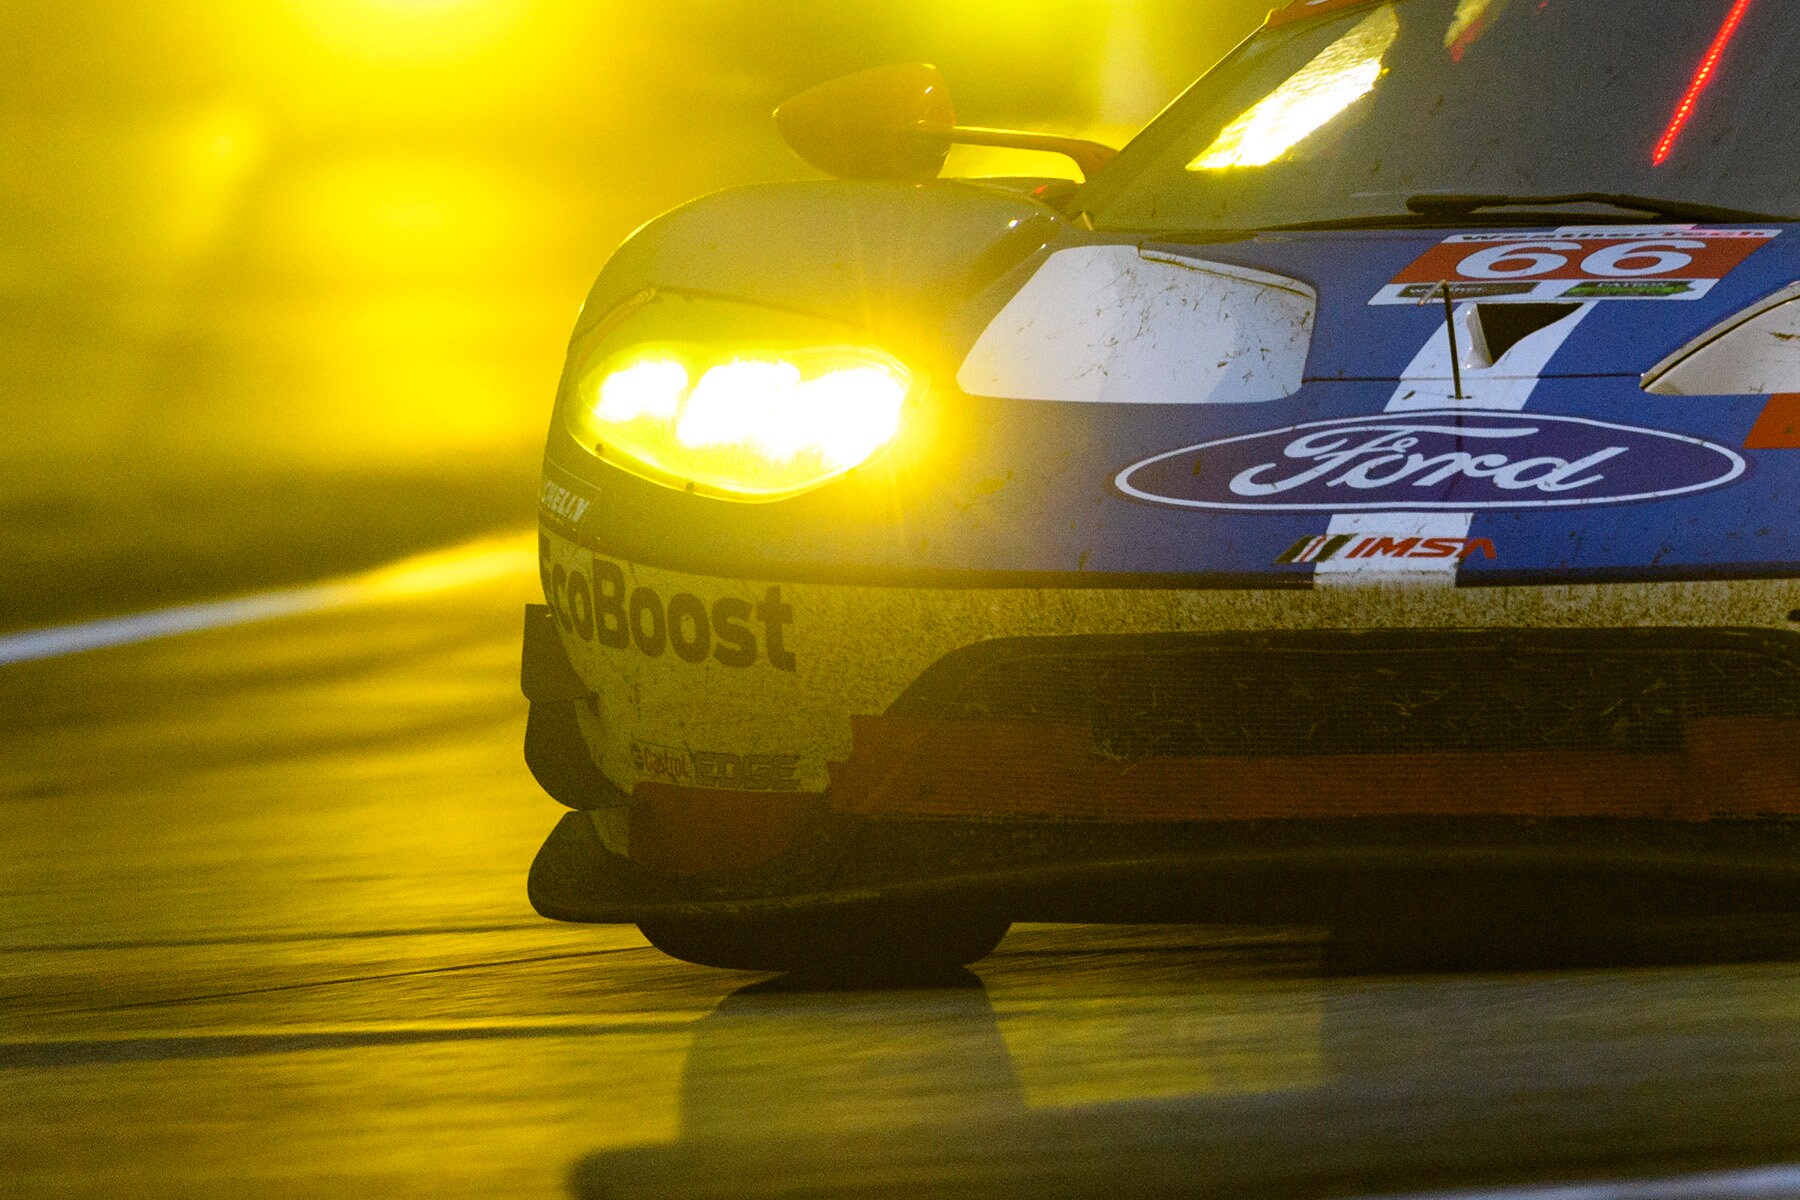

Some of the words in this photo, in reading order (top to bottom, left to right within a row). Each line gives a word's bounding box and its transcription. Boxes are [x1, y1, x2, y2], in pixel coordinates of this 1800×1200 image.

[1455, 239, 1708, 279] 66
[1229, 424, 1628, 496] Ford
[541, 480, 591, 523] CHELIN
[1346, 537, 1498, 560] IMSA
